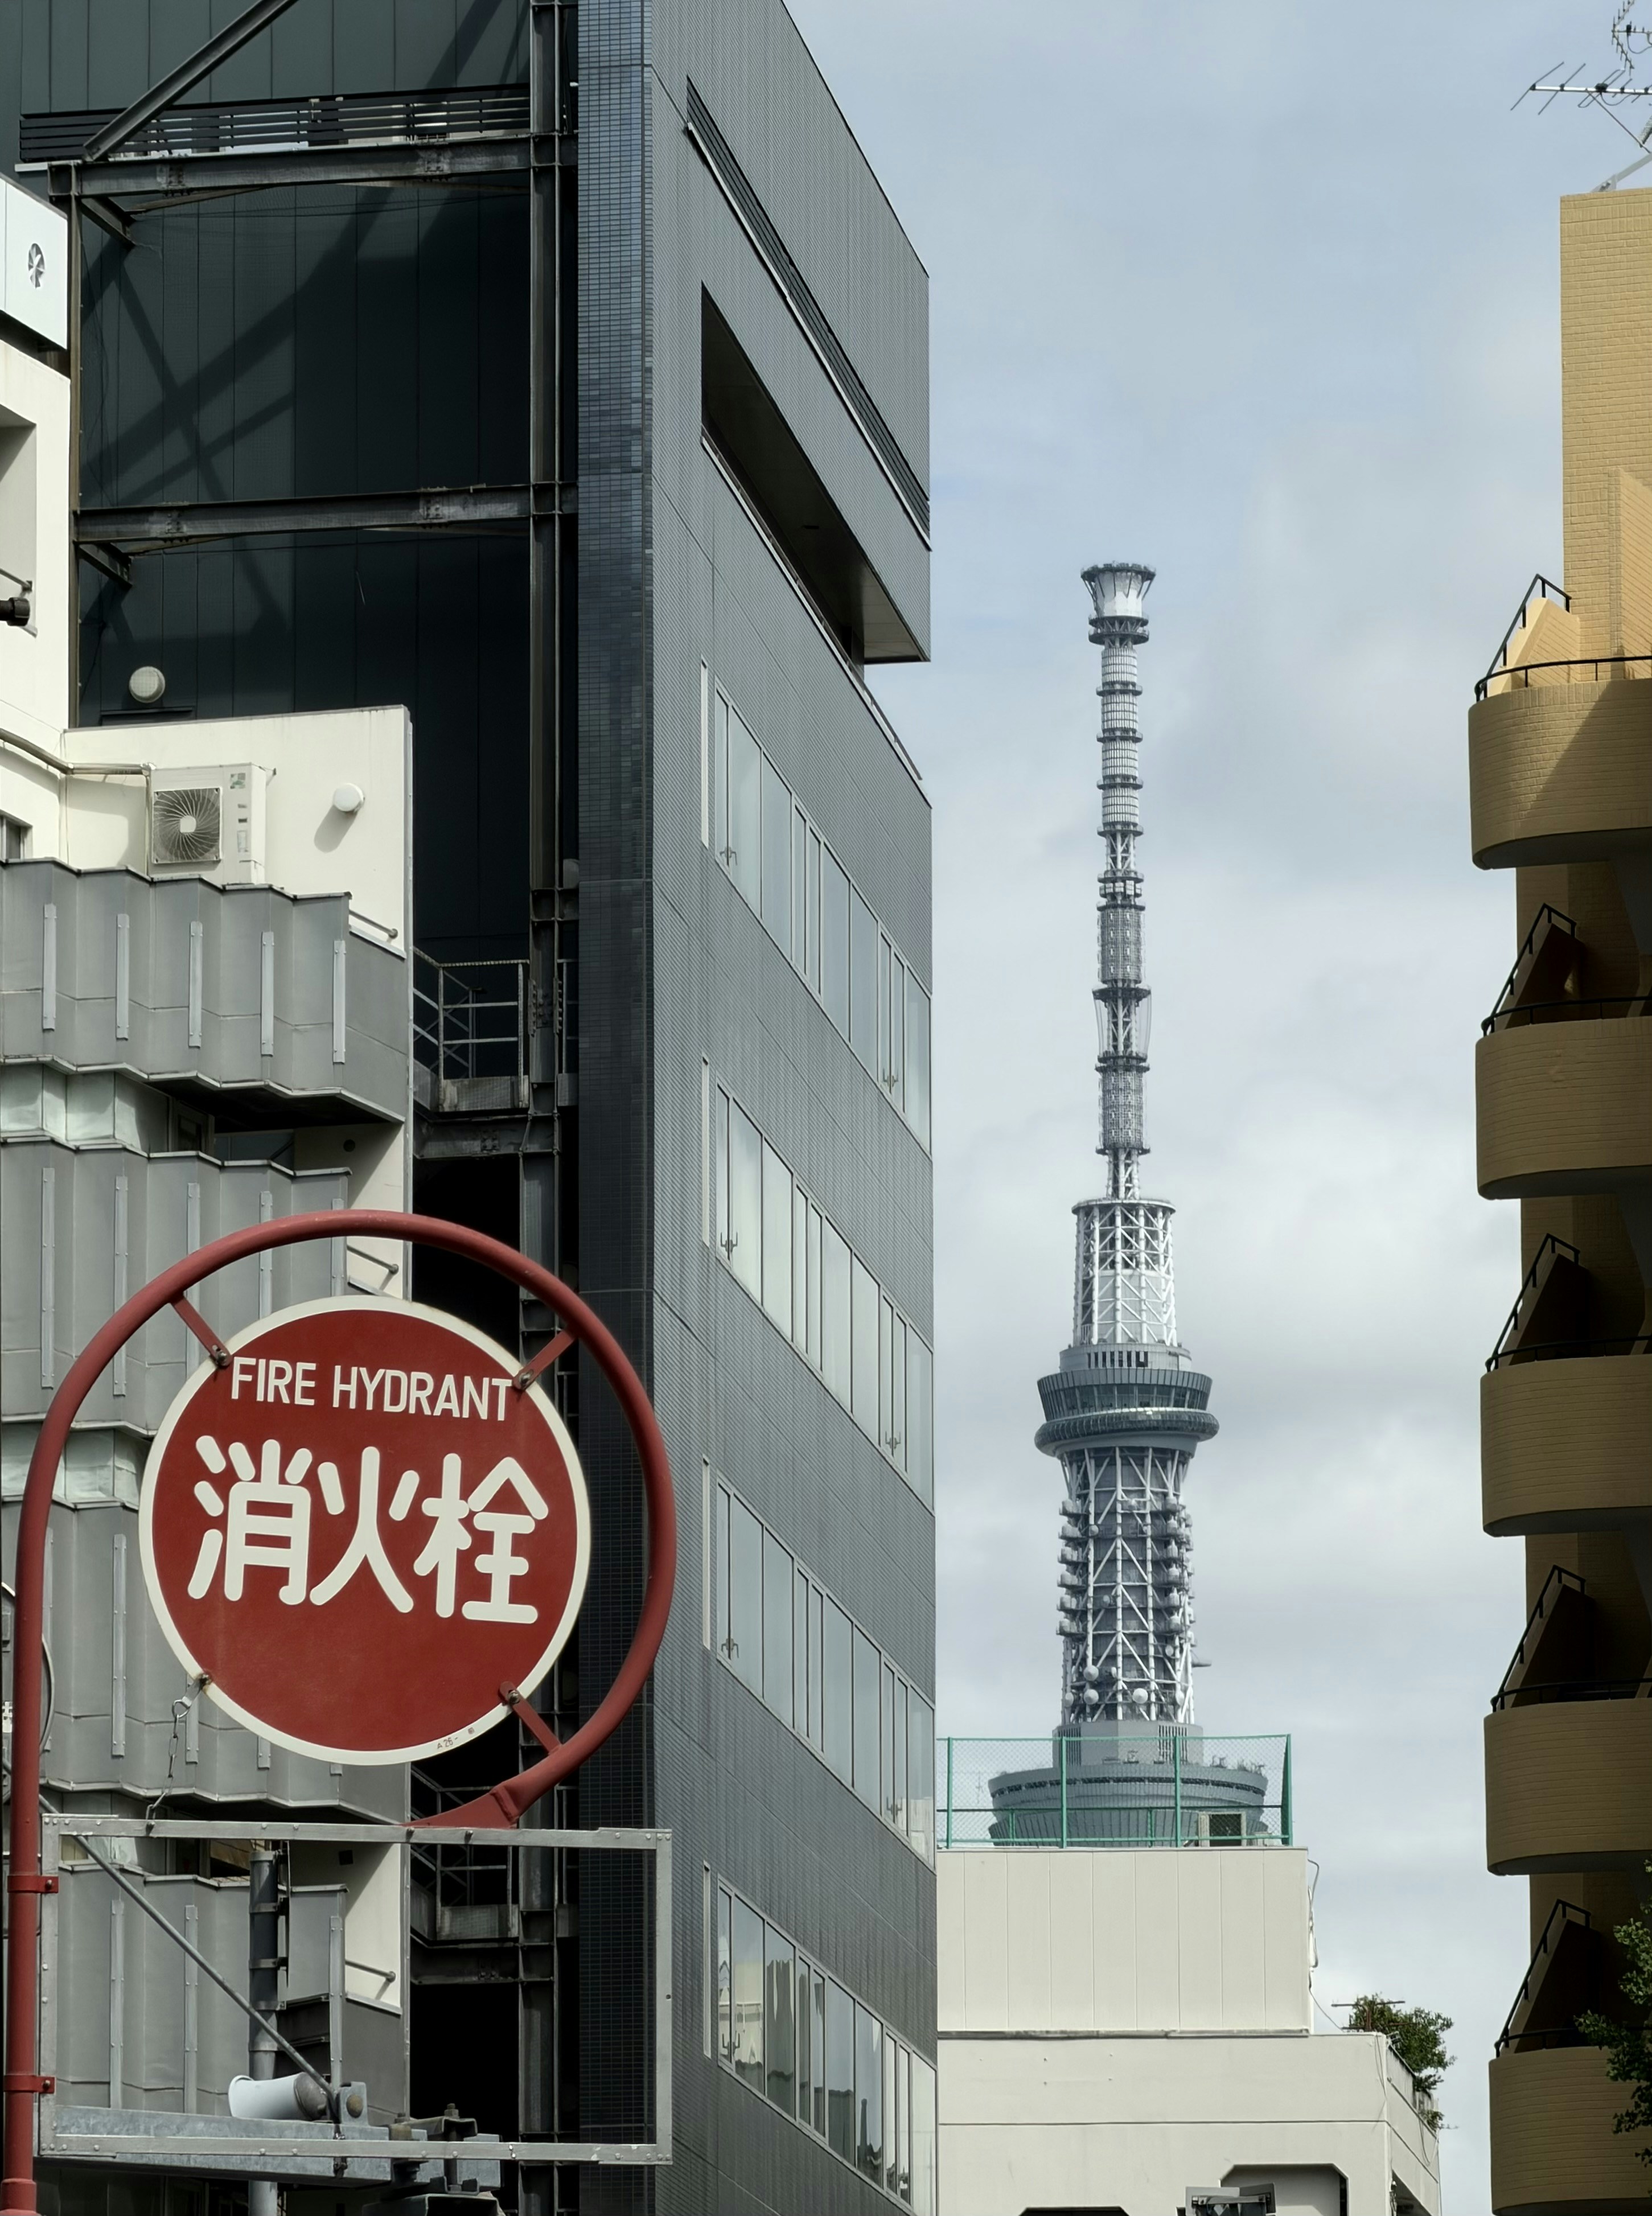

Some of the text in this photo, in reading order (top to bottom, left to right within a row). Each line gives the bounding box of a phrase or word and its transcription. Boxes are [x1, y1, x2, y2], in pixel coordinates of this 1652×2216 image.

[231, 1356, 512, 1421] FIRE HYDRANT
[187, 1435, 549, 1624] 消火栓
